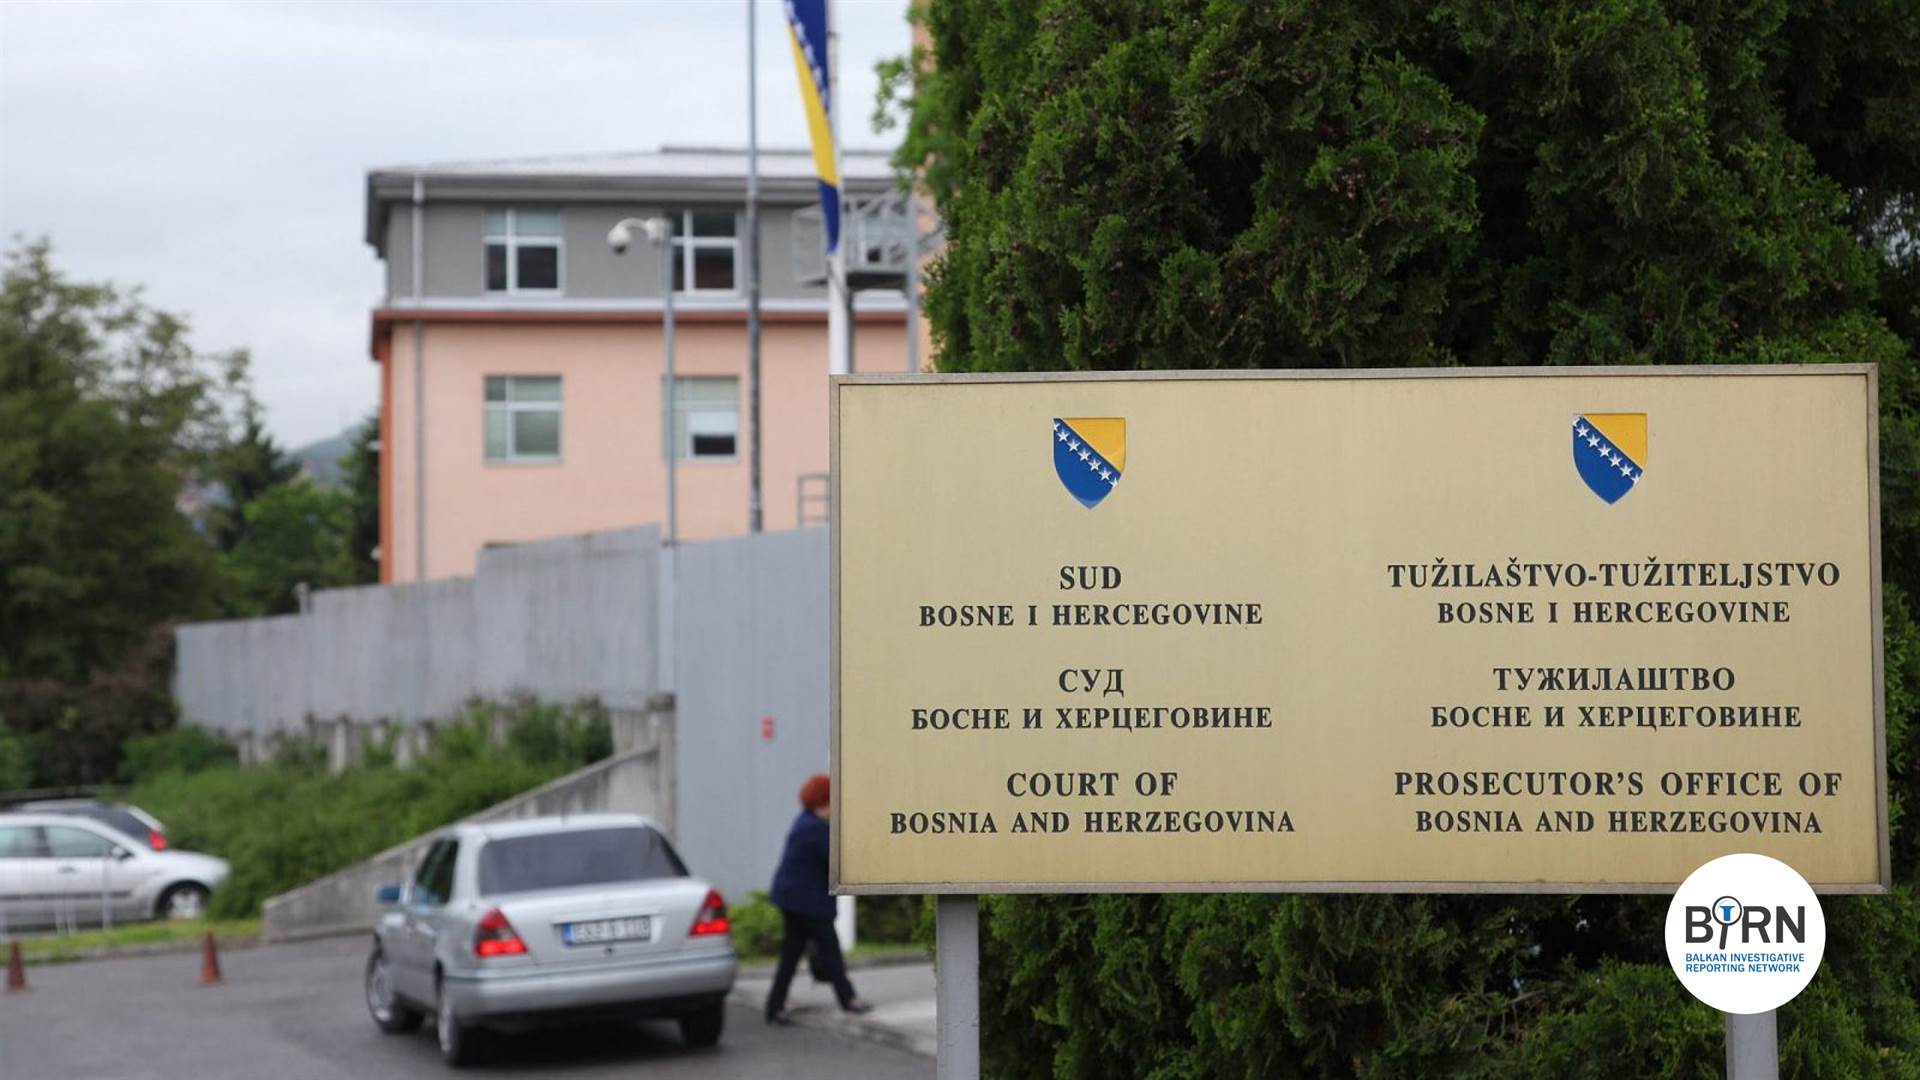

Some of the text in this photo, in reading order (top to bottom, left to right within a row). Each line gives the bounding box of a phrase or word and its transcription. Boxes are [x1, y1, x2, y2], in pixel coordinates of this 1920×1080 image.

[1059, 565, 1122, 591] SUD
[1387, 555, 1840, 589] TUŽILAŠTVO-TUŽITELJSTVO
[919, 603, 1263, 627] BOSNE I HERCEGOVINE
[1437, 601, 1791, 624] BOSNE I HERCEGOVINE
[1058, 668, 1125, 698] СУД
[1492, 667, 1735, 691] ТУЖИЛАШТВО
[911, 707, 1273, 733] БОСНЕ И ХЕРЦЕГОВИНЕ
[1431, 705, 1802, 732] БОСНЕ И ХЕРЦЕГОВИНЕ
[1006, 771, 1178, 798] COURT OF
[1660, 771, 1783, 797] OFFICE
[1798, 771, 1843, 797] OF
[889, 810, 1295, 835] BOSNIA AND HERZEGOVINA
[1415, 810, 1823, 834] BOSNIA AND HERZEGOVINA
